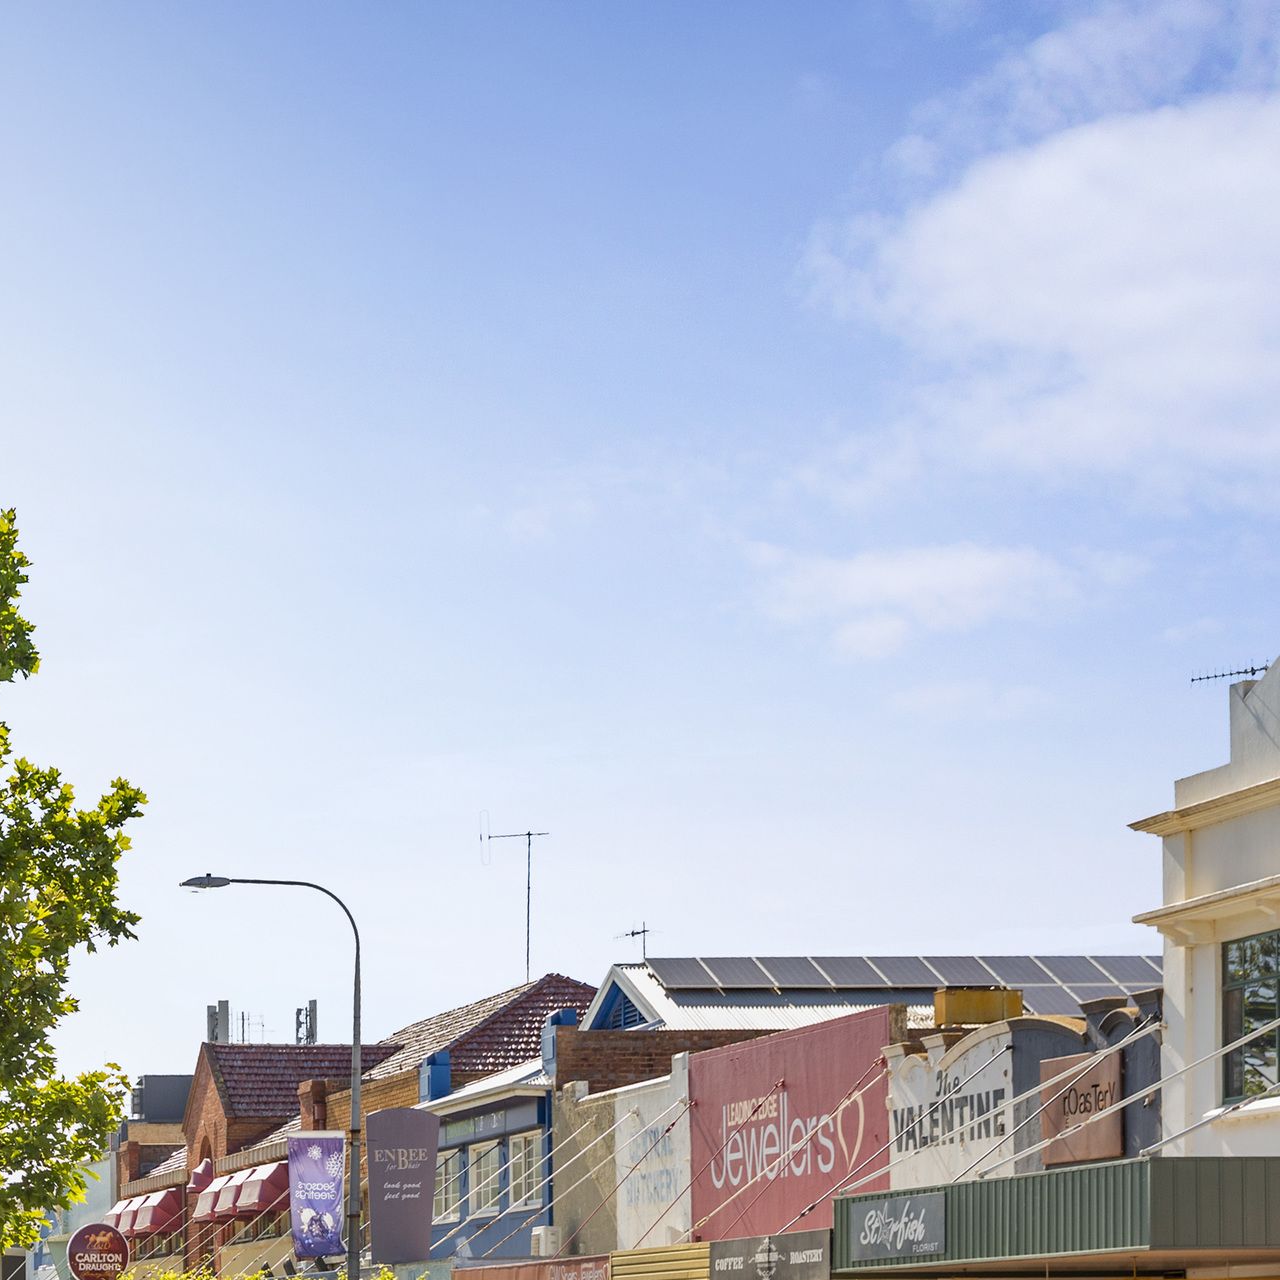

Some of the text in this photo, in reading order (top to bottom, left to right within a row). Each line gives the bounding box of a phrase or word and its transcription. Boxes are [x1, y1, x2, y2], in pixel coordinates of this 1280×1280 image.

[936, 1070, 962, 1097] The
[728, 1094, 778, 1126] LEADING EDGE
[893, 1088, 1005, 1153] VALENTINE
[710, 1092, 834, 1189] Jewellers
[374, 1148, 428, 1169] ENBEE
[384, 1192, 420, 1200] feel good
[402, 1182, 421, 1190] good
[76, 1253, 122, 1262] CARLTON
[913, 1242, 938, 1252] FLORIST
[715, 1257, 743, 1271] COFFEE
[790, 1248, 823, 1264] ROASTERY
